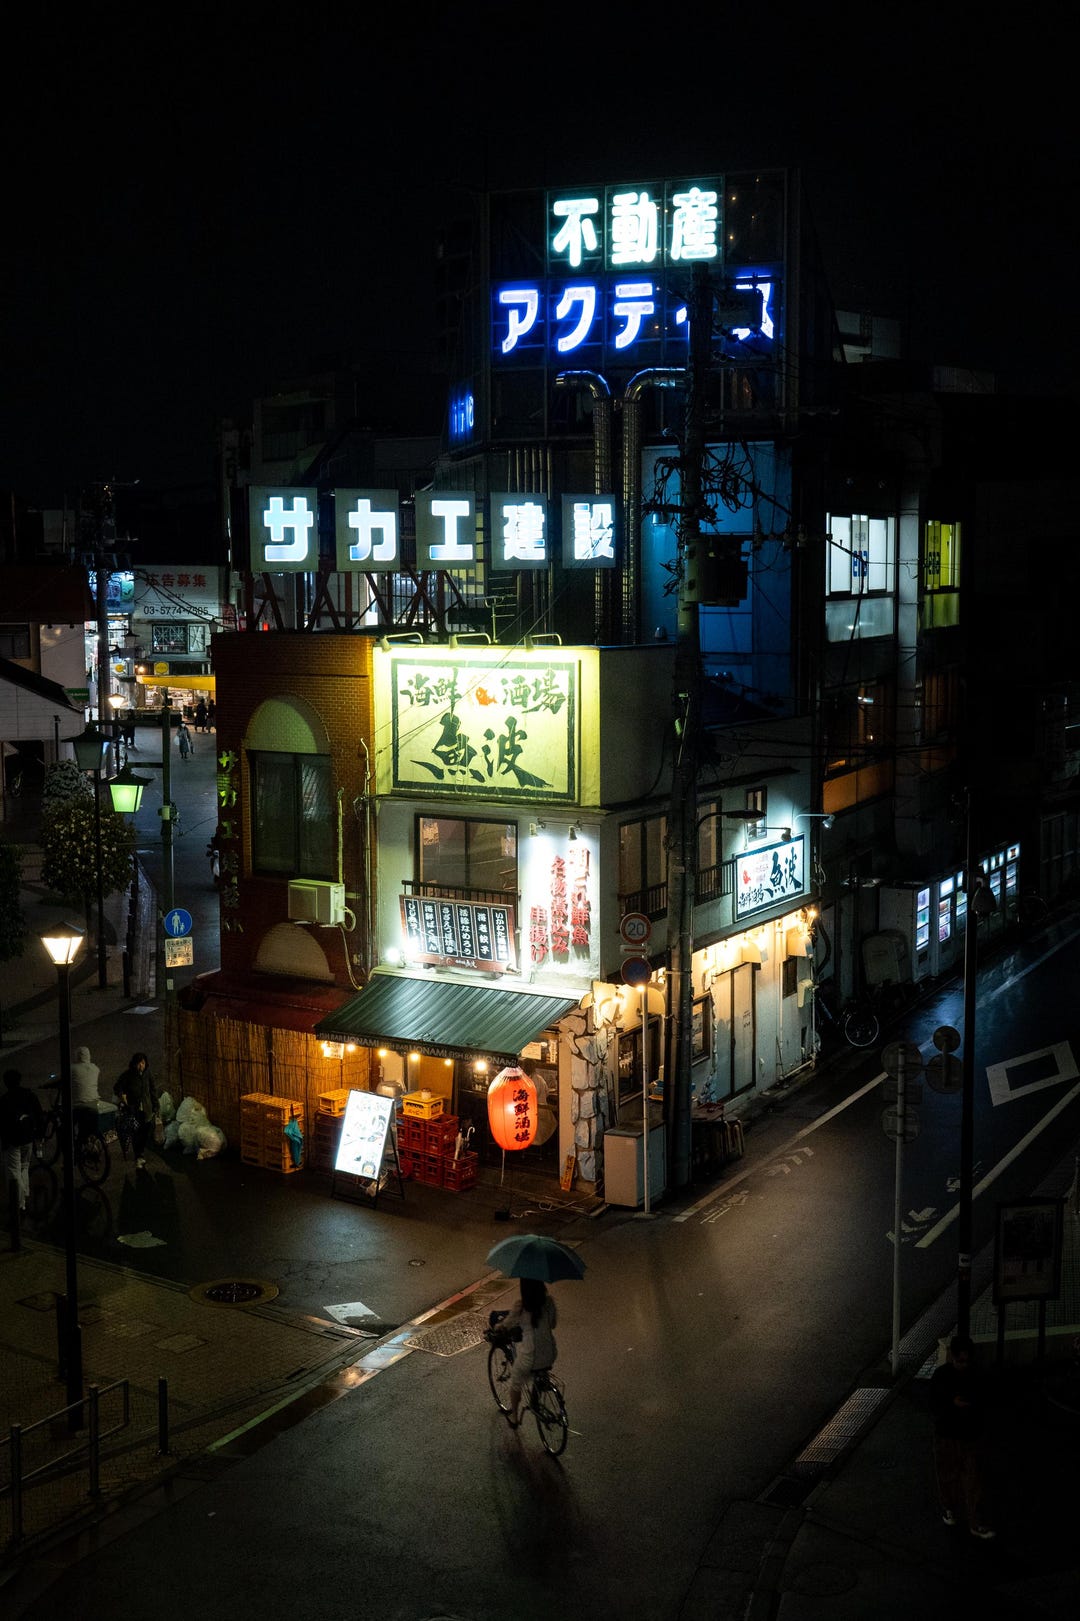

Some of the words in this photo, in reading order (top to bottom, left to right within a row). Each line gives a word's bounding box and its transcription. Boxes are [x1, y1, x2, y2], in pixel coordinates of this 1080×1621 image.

[553, 187, 718, 267] 不動産
[500, 274, 775, 354] アクテス
[264, 496, 615, 562] サカエ建設
[627, 922, 645, 936] 20
